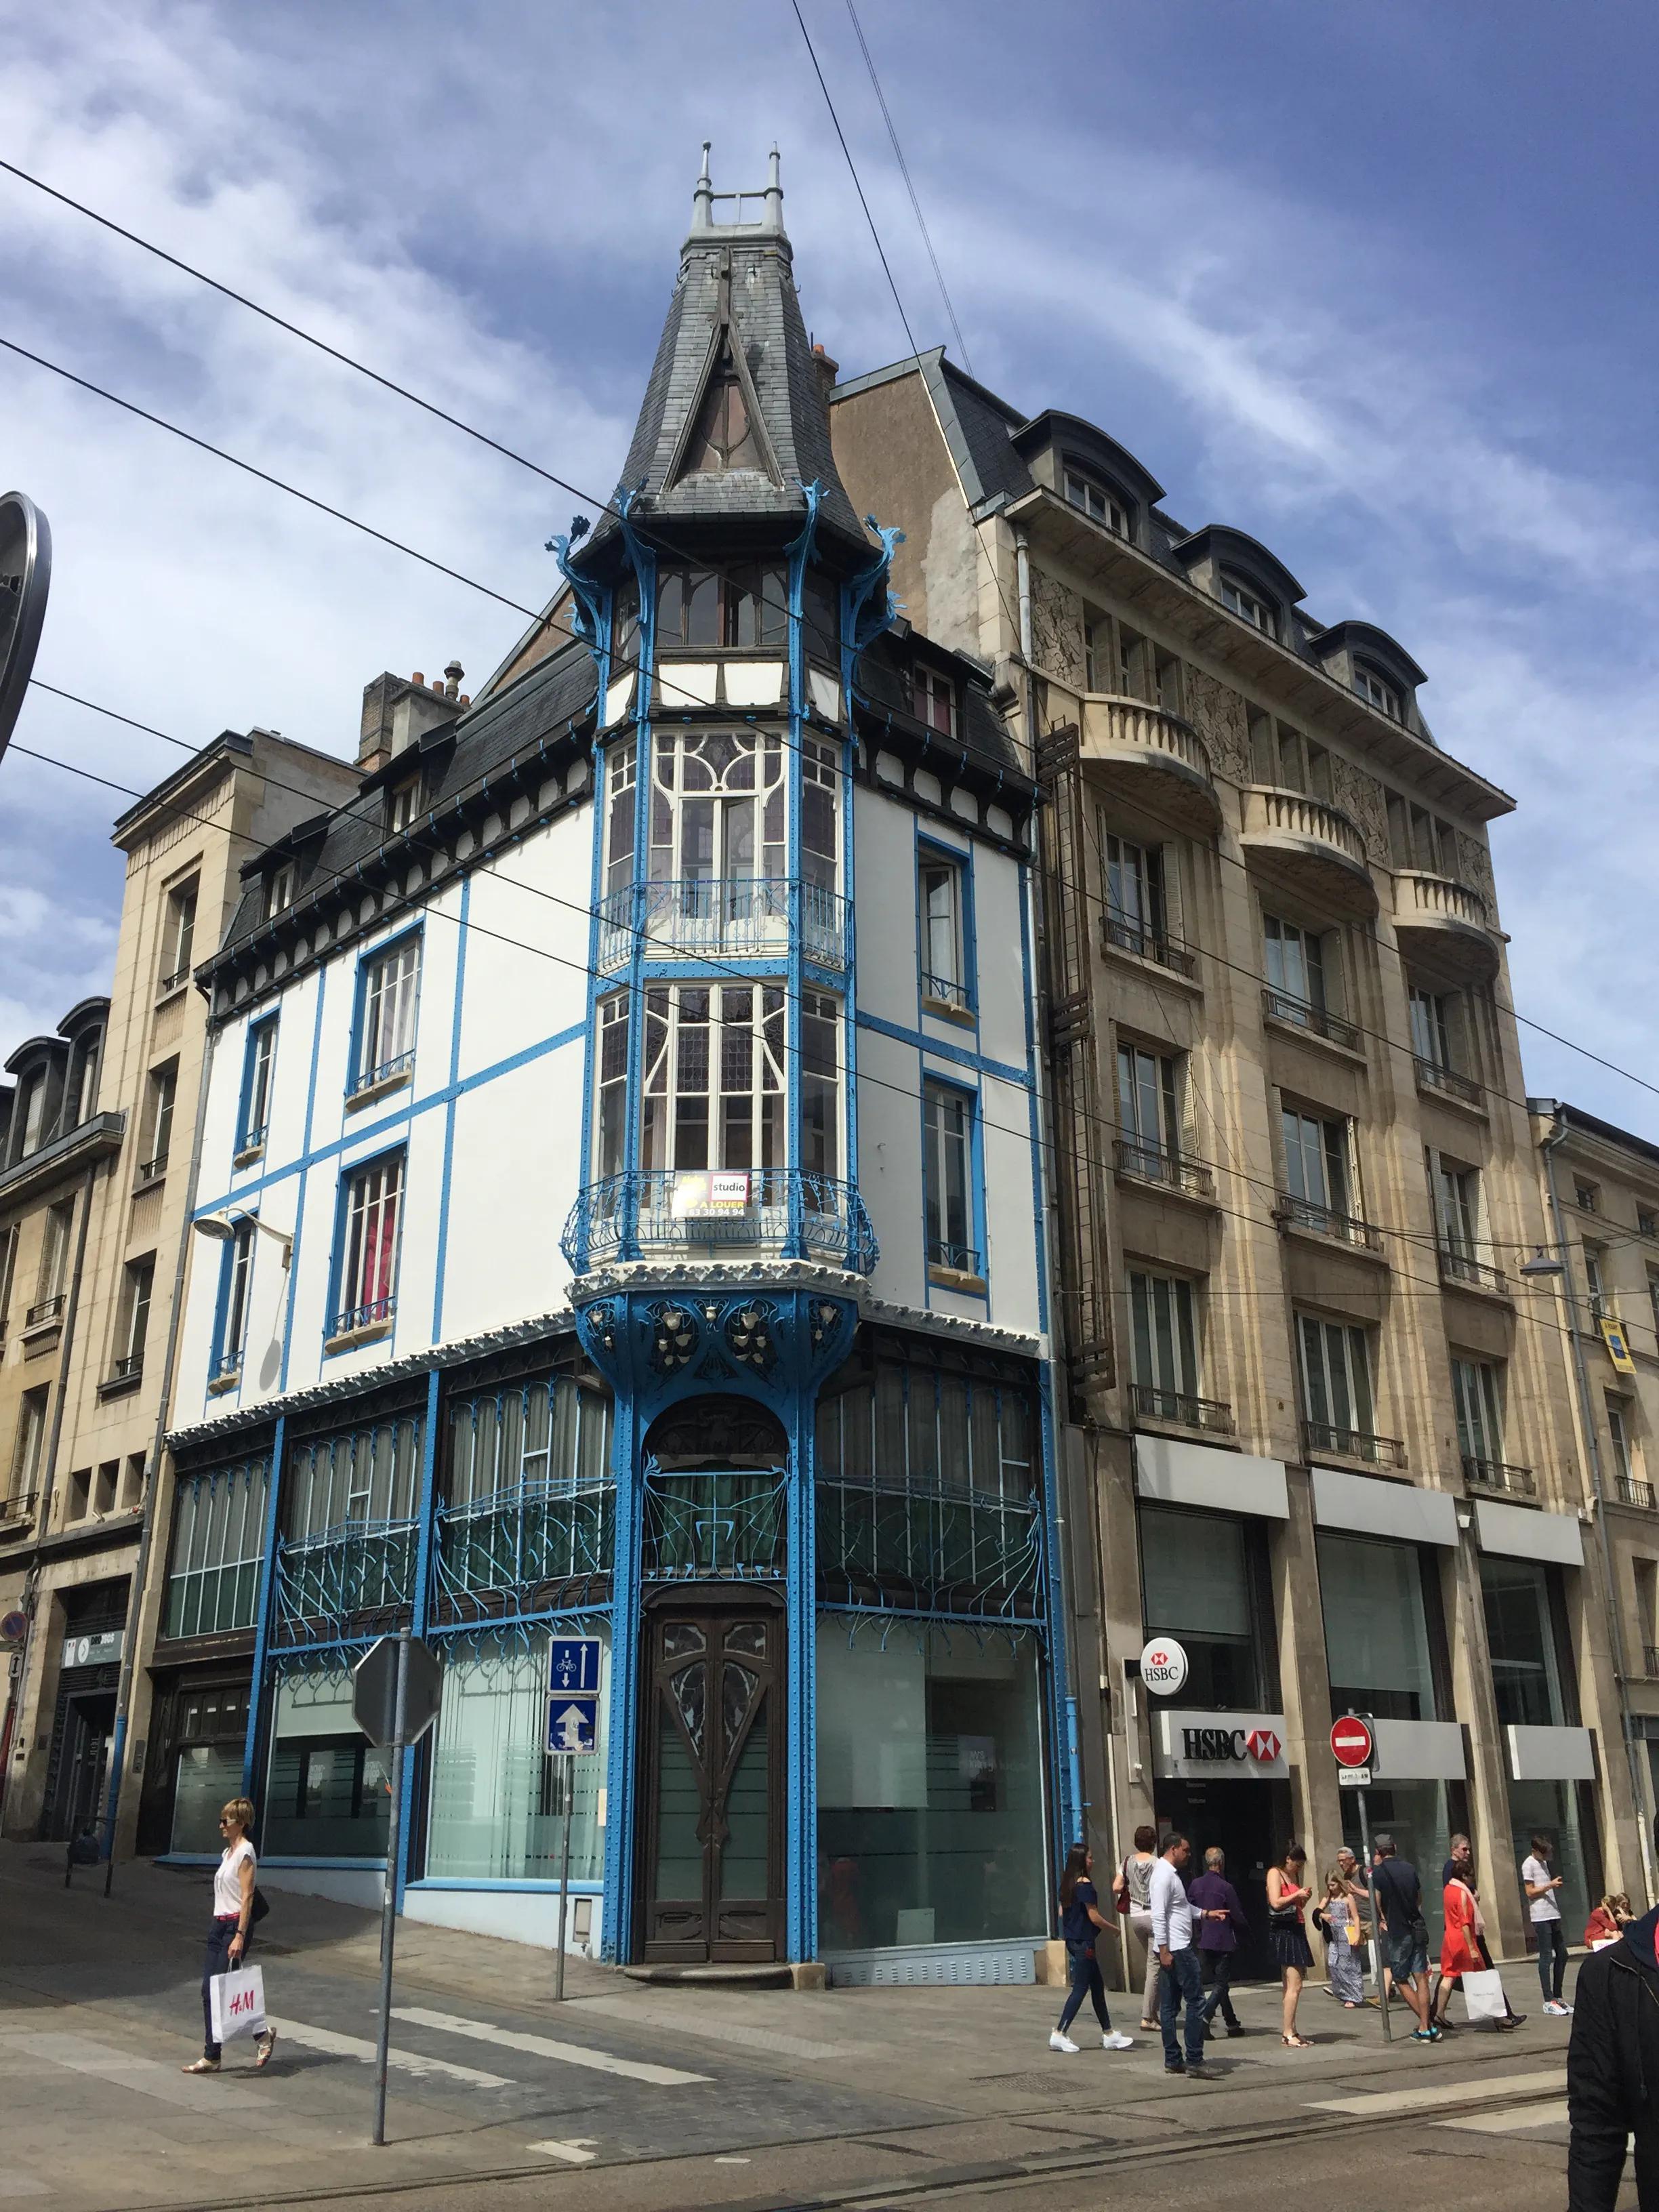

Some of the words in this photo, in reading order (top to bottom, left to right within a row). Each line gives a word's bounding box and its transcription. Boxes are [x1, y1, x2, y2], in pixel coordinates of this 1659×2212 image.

[713, 1181, 745, 1191] studio
[710, 1200, 744, 1208] LOUER
[1145, 1666, 1179, 1681] HSBC
[1181, 1728, 1248, 1761] HSBC
[229, 1990, 254, 2017] H&M
